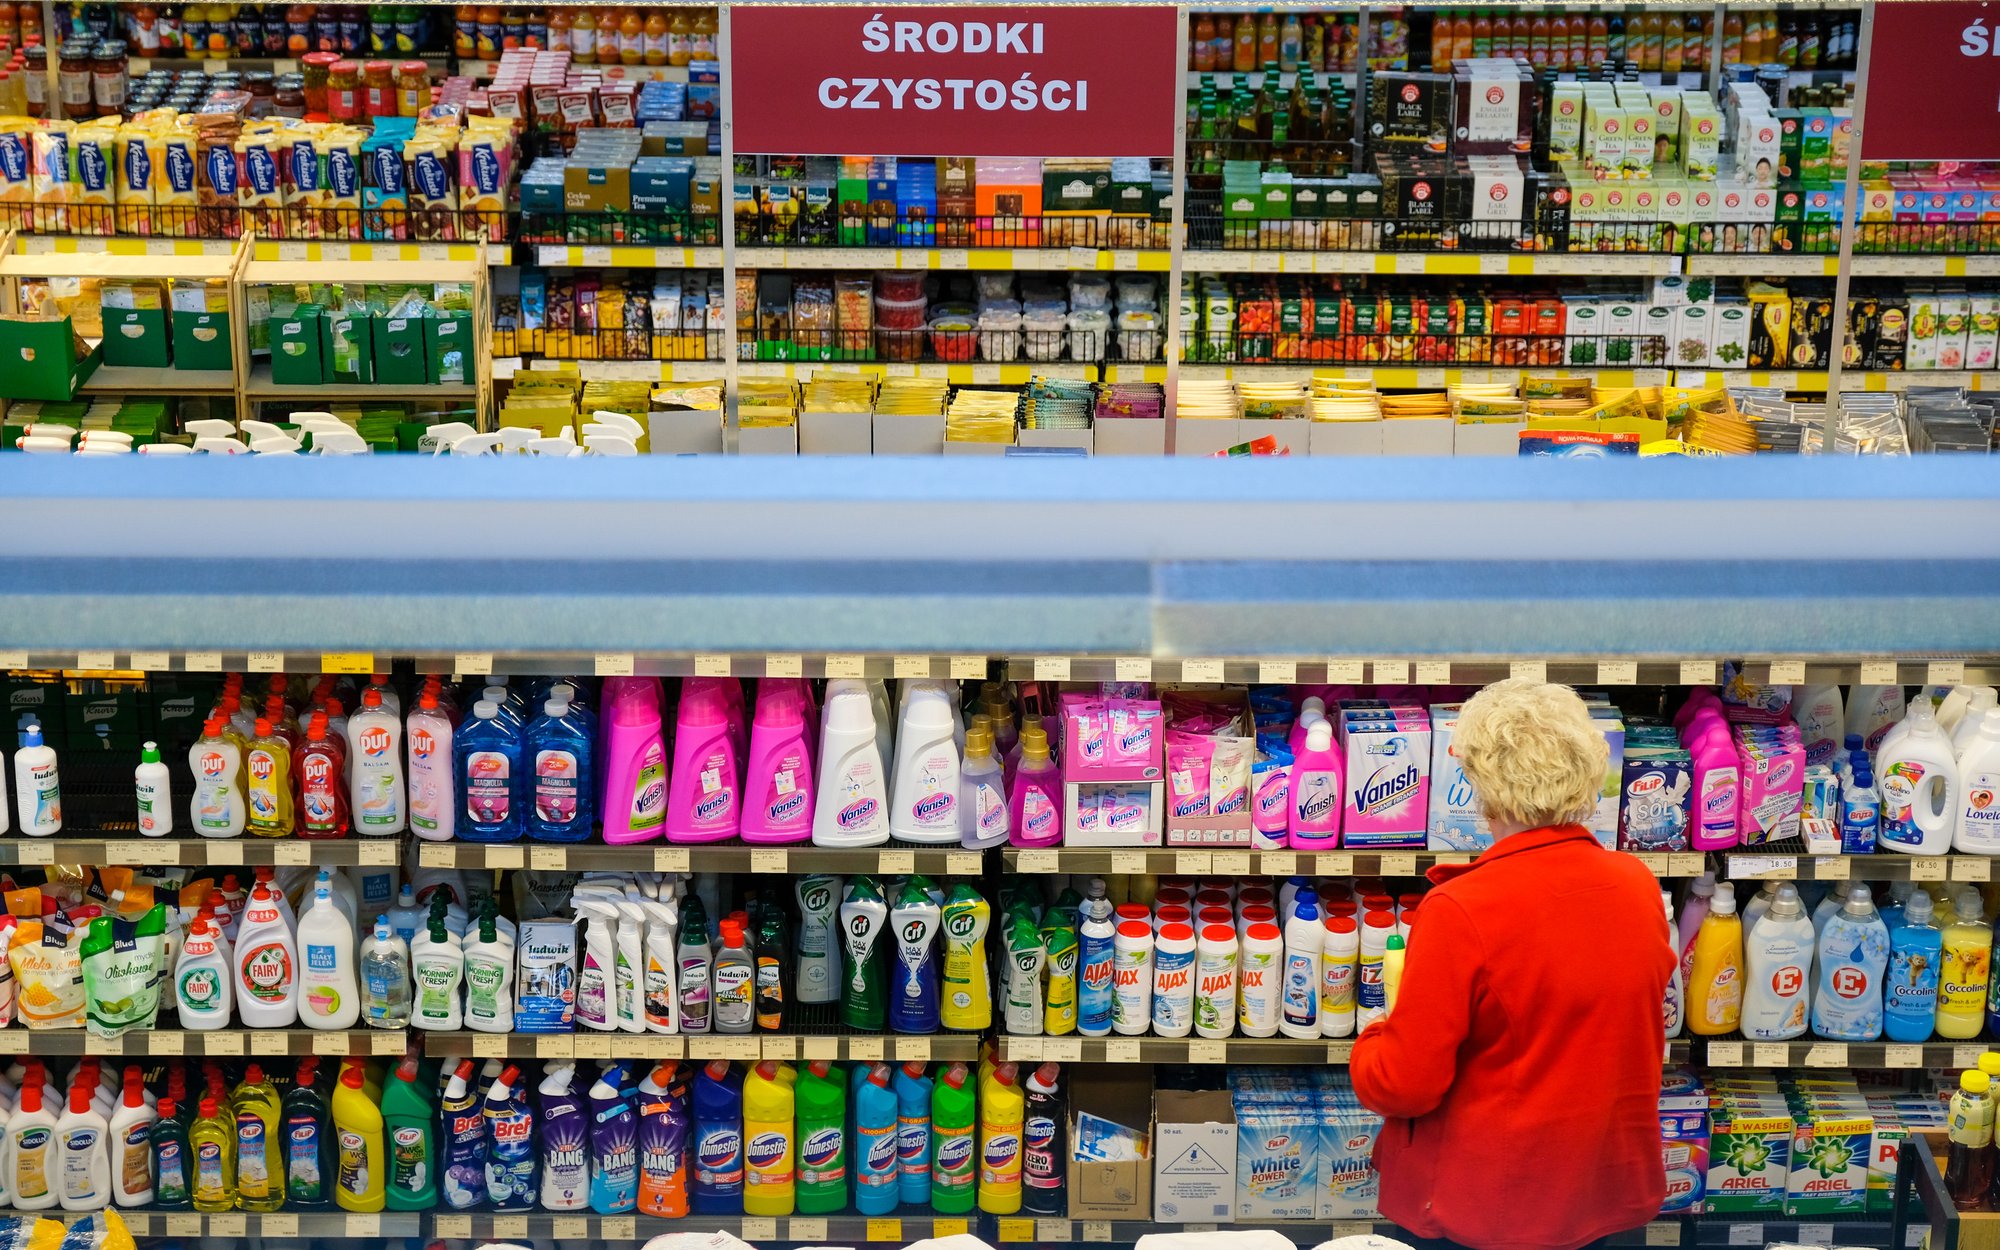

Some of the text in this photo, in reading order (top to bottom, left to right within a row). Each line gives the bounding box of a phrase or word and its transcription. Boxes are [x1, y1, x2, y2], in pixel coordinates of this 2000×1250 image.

[862, 14, 1044, 54] ŚRODKI
[1959, 17, 2000, 57] Ś
[818, 72, 1088, 113] CZYSTOŚCI
[1397, 102, 1423, 111] BLACK
[1398, 110, 1422, 118] LABEL
[632, 194, 667, 204] Premium
[1408, 201, 1434, 209] BLACK
[1409, 207, 1434, 215] LABEL
[361, 733, 391, 754] pur
[411, 733, 435, 753] pur
[1123, 728, 1151, 751] Vanish
[201, 756, 226, 773] pur
[251, 760, 273, 777] pur
[306, 765, 328, 781] pur
[1758, 762, 1767, 770] 20
[473, 778, 504, 787] MAGNOLIA
[1354, 764, 1420, 816] Vanish
[636, 780, 665, 813] Vanish
[697, 790, 729, 819] Vanish
[1706, 789, 1733, 812] Vanish
[771, 793, 803, 819] Vanish
[841, 797, 874, 827] Vanish
[915, 796, 950, 820] Vanish
[1298, 790, 1337, 821] Vanish
[1637, 797, 1674, 821] SÓL
[983, 805, 1004, 827] Vanish
[1028, 809, 1052, 829] Vanish
[1110, 806, 1139, 826] Vanish
[1850, 809, 1875, 821] Bryza
[1770, 860, 1793, 868] 18.50
[1915, 860, 1938, 870] 46.50
[807, 890, 828, 908] Cif
[851, 918, 869, 935] Cif
[904, 921, 924, 941] Cif
[951, 913, 974, 934] Cif
[45, 935, 66, 948] Blue
[115, 939, 134, 950] Blue
[528, 943, 570, 955] ludwik
[252, 962, 279, 977] FAIRY
[1020, 956, 1036, 971] Cif
[1060, 952, 1074, 970] Cif
[419, 969, 455, 980] MORNING
[424, 976, 449, 986] FRESH
[469, 967, 501, 979] MORNING
[472, 974, 495, 985] FRESH
[716, 968, 749, 979] ludwik
[1157, 969, 1188, 992] AJAX
[188, 981, 210, 995] FAIRY
[1202, 972, 1233, 995] AJAX
[1895, 984, 1937, 997] Coccolino
[1944, 982, 1987, 994] Coccolino
[494, 1114, 532, 1138] Bref
[1743, 1121, 1791, 1131] WASHES
[1825, 1123, 1872, 1134] WASHES
[700, 1139, 740, 1157] Domestos
[748, 1140, 788, 1156] Domestos
[803, 1137, 843, 1157] Domestos
[938, 1142, 974, 1160] Domestos
[984, 1142, 1019, 1157] Domestos
[550, 1149, 584, 1167] BANG
[603, 1148, 636, 1171] BANG
[643, 1150, 676, 1173] BANG
[1027, 1153, 1048, 1165] ZERO
[1251, 1156, 1302, 1175] White
[1251, 1171, 1286, 1183] POWER
[1332, 1171, 1366, 1183] POWER
[1721, 1176, 1771, 1189] ARIEL
[1803, 1179, 1852, 1192] ARIEL
